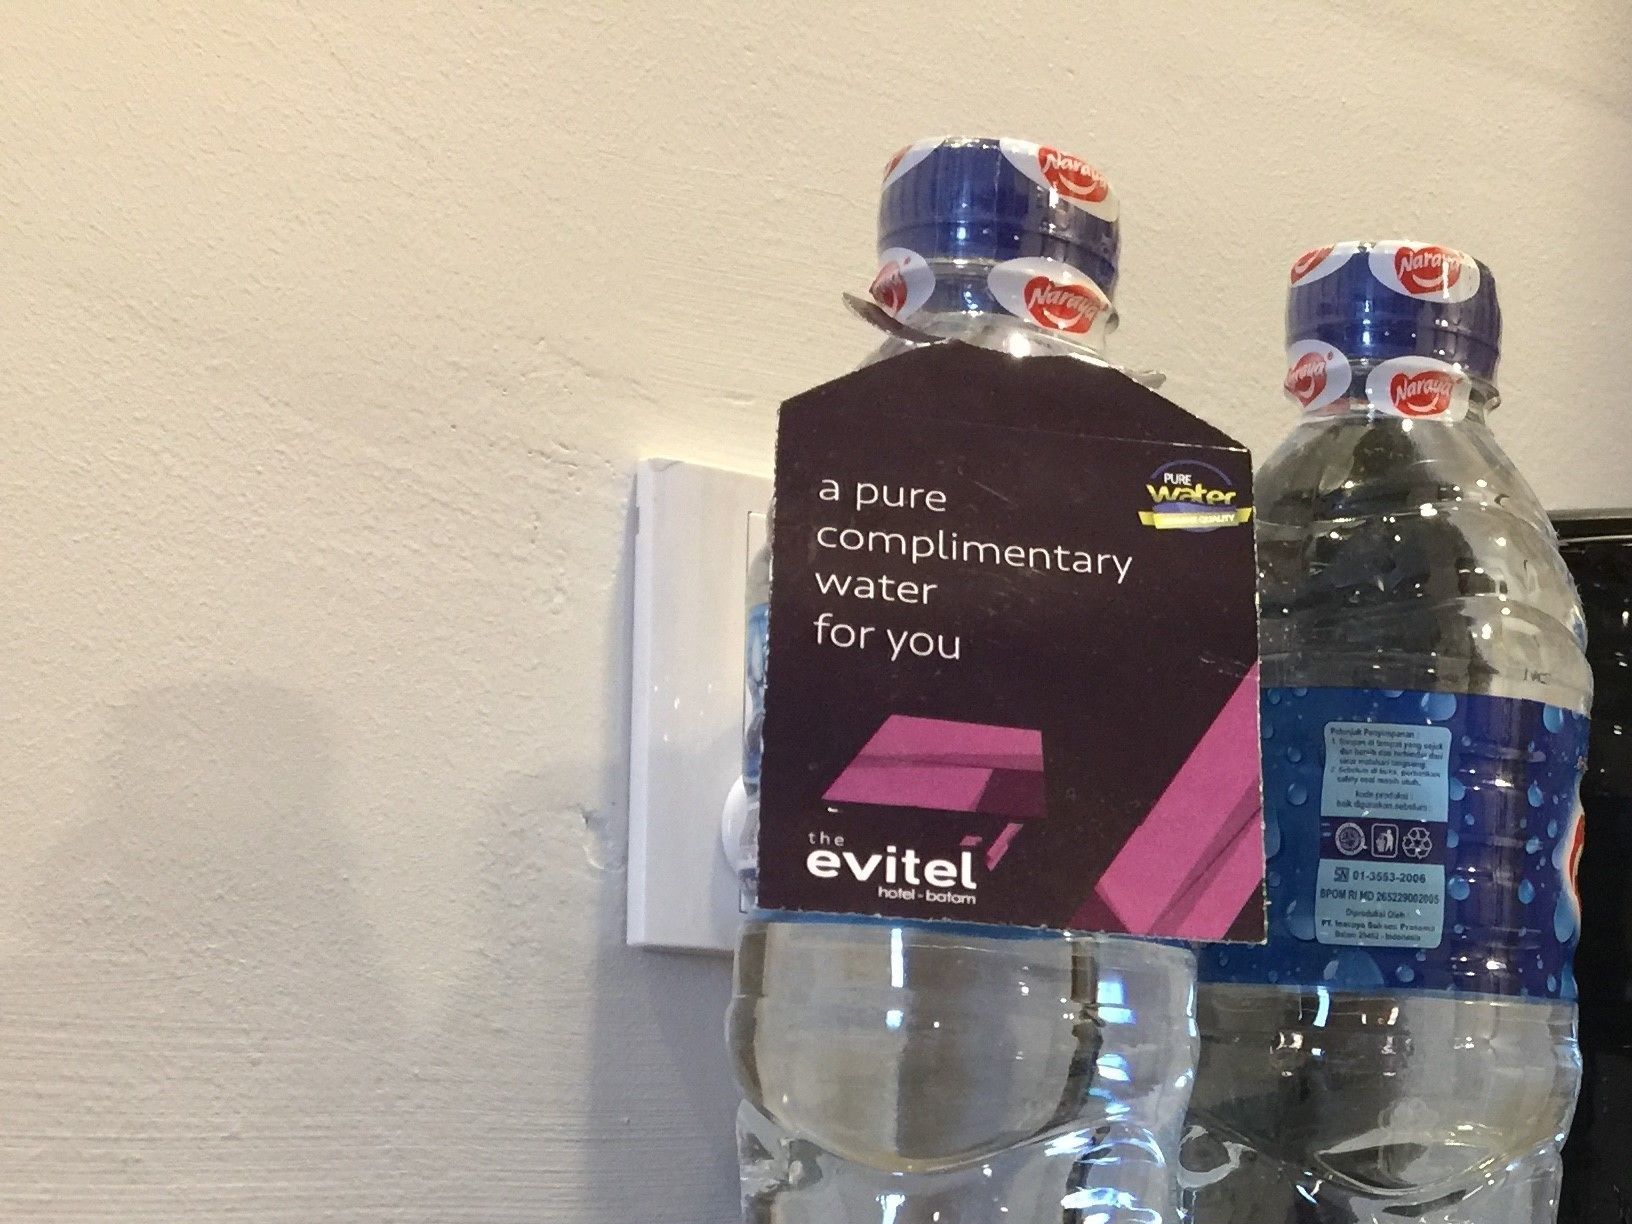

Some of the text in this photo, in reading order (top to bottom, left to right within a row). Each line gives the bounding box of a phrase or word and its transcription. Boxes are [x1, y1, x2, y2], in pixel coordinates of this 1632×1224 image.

[1395, 377, 1451, 407] Naraya
[1145, 483, 1237, 505] water
[1163, 472, 1192, 486] PURE
[819, 478, 947, 513] a pure
[816, 525, 1133, 584] complimentary
[814, 571, 938, 605] water
[813, 612, 961, 662] for you
[808, 831, 845, 847] the
[806, 845, 977, 890] evitel
[878, 886, 977, 905] hotel batam
[1320, 888, 1346, 900] BPOM
[1348, 889, 1358, 900] RI
[1360, 889, 1374, 901] MD
